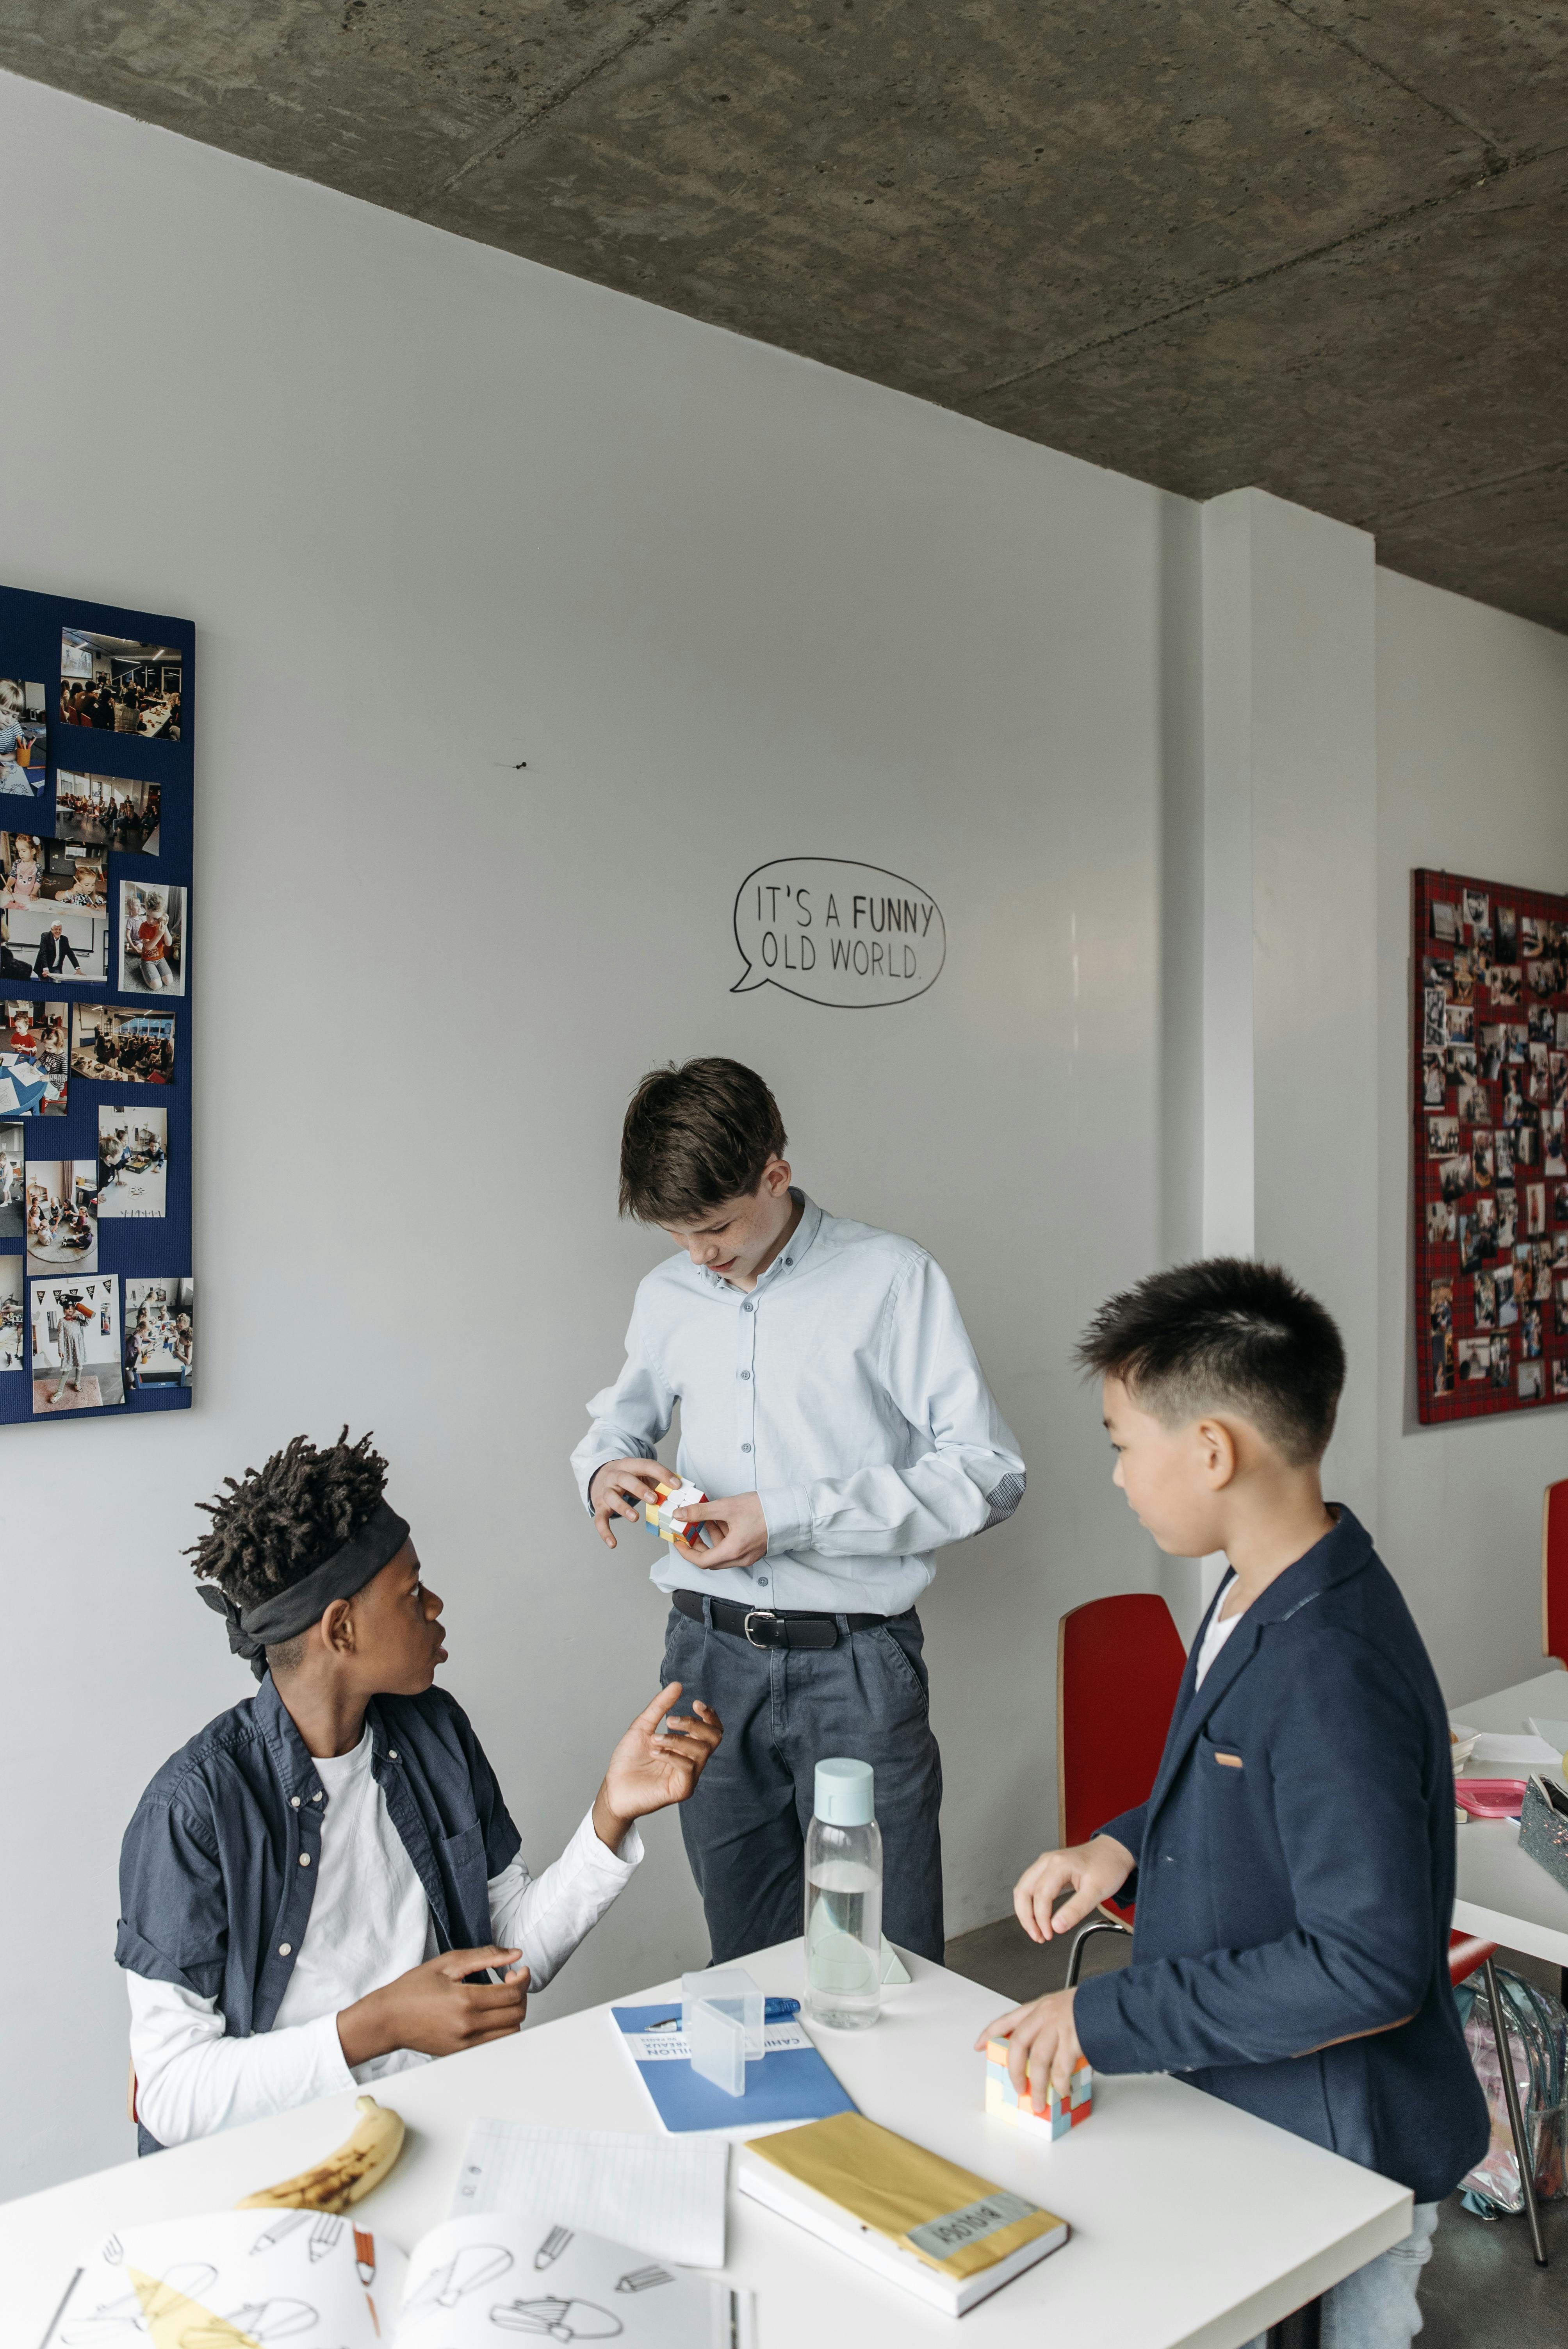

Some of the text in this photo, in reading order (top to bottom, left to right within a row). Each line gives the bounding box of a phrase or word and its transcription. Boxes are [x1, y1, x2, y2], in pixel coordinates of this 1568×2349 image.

[758, 885, 933, 937] IT'S A FUNNY
[762, 931, 816, 970] OLD
[764, 2038, 800, 2047] CAHI
